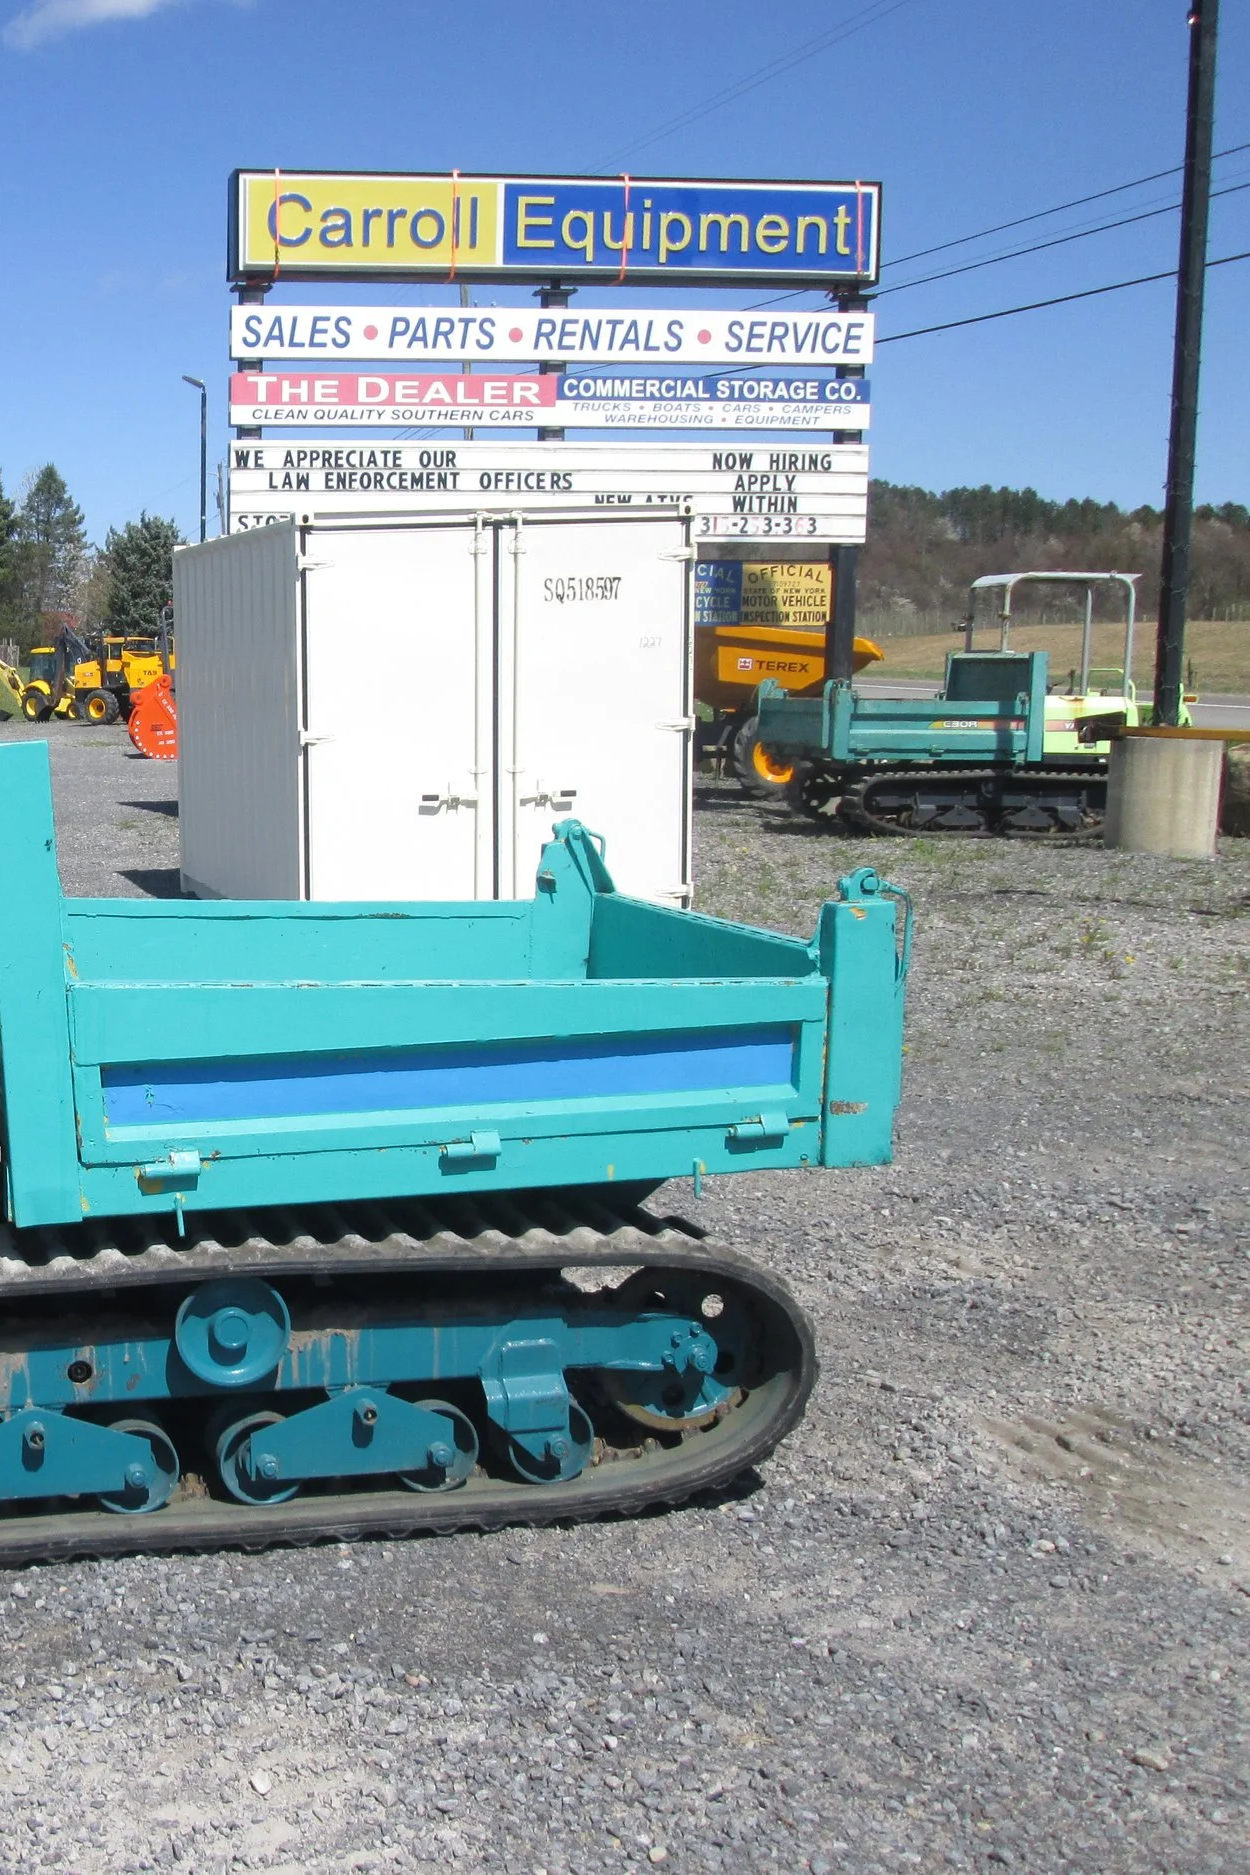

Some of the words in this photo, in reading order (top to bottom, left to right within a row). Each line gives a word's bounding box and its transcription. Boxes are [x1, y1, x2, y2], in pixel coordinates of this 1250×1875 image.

[267, 192, 479, 249] Carroll
[516, 195, 851, 264] Equipment
[242, 314, 352, 349] SALES
[388, 316, 496, 351] PARTS
[533, 318, 684, 352] RENTALS
[724, 320, 865, 354] SERVICE
[246, 375, 340, 403] THE
[357, 376, 541, 405] DEALER
[562, 378, 711, 399] COMMERCIAL
[716, 380, 819, 400] STORAGE
[824, 382, 862, 401] CO.
[251, 408, 312, 420] CLEAN
[313, 408, 386, 421] QUALITY
[391, 409, 487, 421] SOUTHERN
[488, 409, 535, 422] CARS
[572, 401, 632, 412] TRUCKS
[652, 402, 701, 413] BOATS
[722, 403, 761, 414] CARS
[781, 404, 851, 415] CAMPERS
[604, 413, 714, 425] WAREHOUSING
[734, 415, 821, 426] EQUIPMENT
[234, 449, 265, 469] WE
[283, 449, 402, 469] APPRECIATE
[418, 449, 457, 469] OUR
[712, 452, 753, 471] NOW
[769, 453, 832, 472] HIRING
[268, 471, 310, 490] LAW
[325, 471, 461, 490] ENFORCEMENT
[479, 472, 573, 491] OFFICERS
[734, 474, 797, 492] APPLY
[731, 495, 799, 513] WITHIN
[238, 514, 289, 529] STO
[748, 564, 824, 584] OFFICIAL
[543, 576, 622, 604] SQ518597
[742, 595, 778, 607] MOTOR
[781, 595, 827, 608] VEHICLE
[741, 610, 790, 623] INSPECTION
[792, 610, 827, 623] STATION
[756, 659, 810, 674] TEREX
